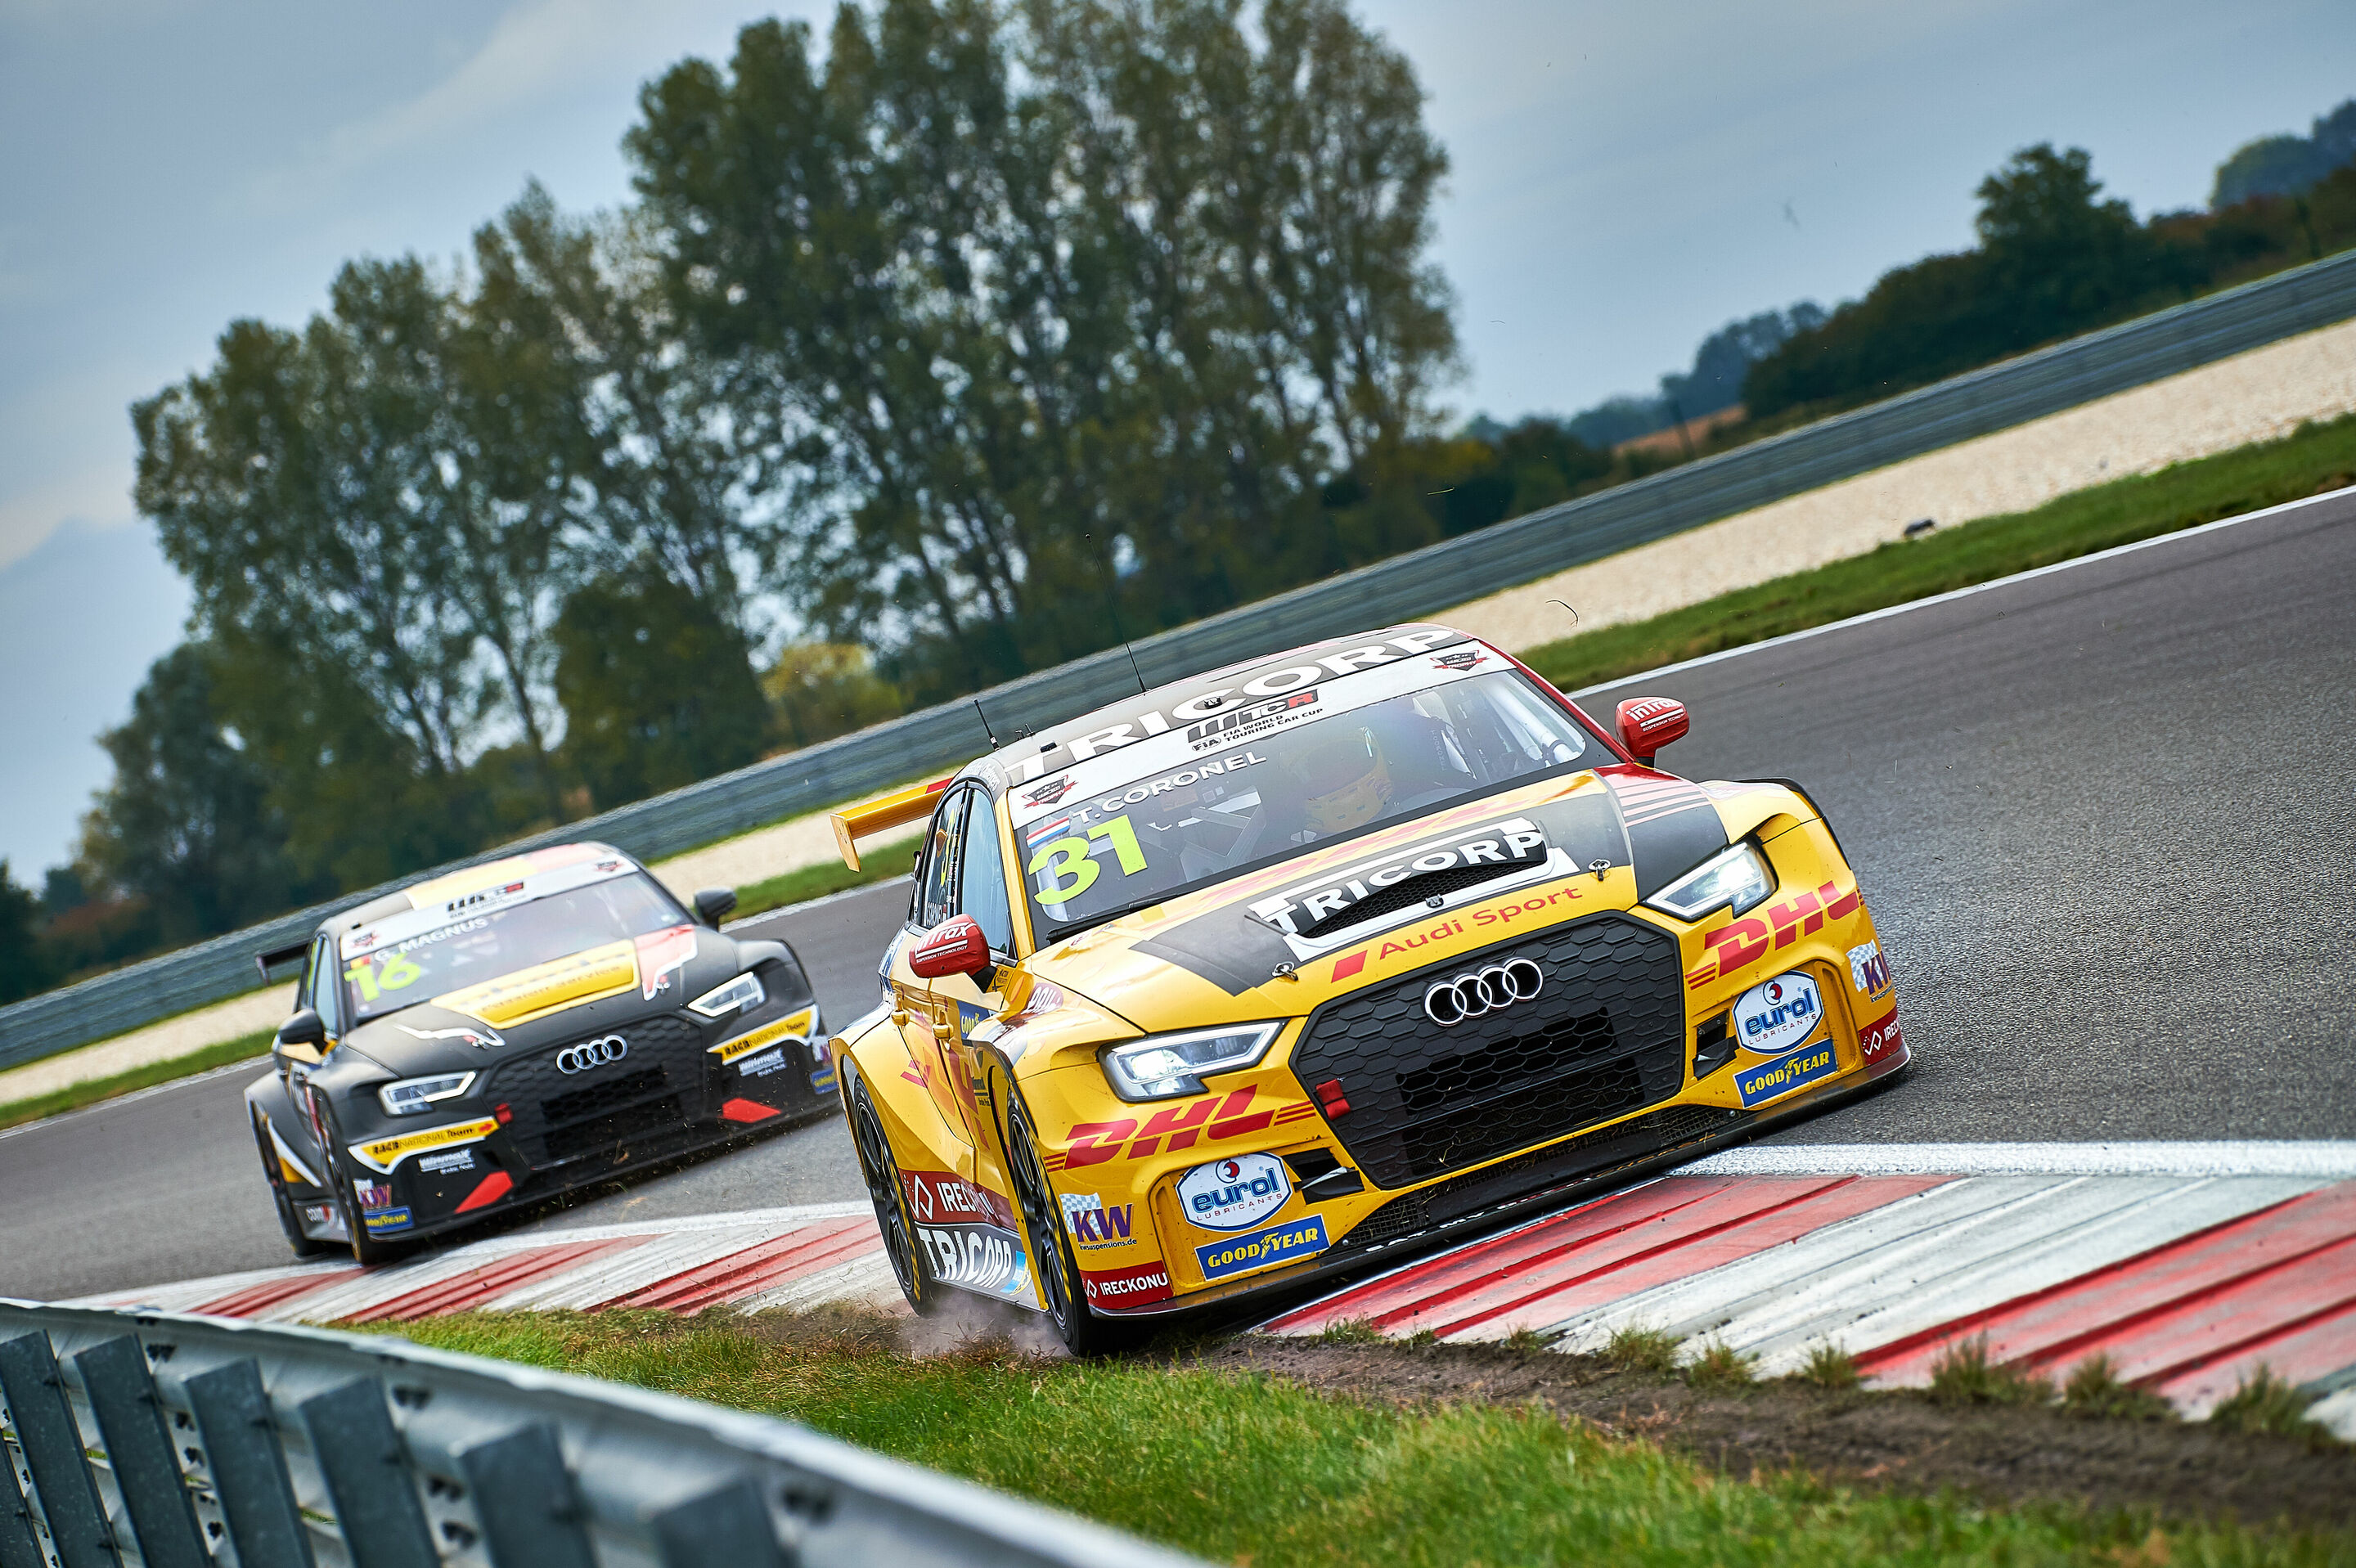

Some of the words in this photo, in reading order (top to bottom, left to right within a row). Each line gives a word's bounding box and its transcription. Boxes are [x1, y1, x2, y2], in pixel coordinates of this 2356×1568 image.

[1005, 629, 1455, 780] TRICORP
[1223, 729, 1241, 738] FIA
[1243, 715, 1284, 730] WORLD
[1225, 724, 1275, 742] TOURING
[1277, 716, 1299, 725] CAR
[1302, 708, 1324, 718] CUP
[1194, 739, 1219, 752] FIA
[1027, 814, 1148, 905] 31
[1264, 830, 1543, 933] TRICORP
[398, 918, 488, 955] MAGNUS
[1379, 918, 1462, 960] Audi
[1472, 884, 1582, 927] Sport
[1704, 880, 1860, 978] DHL
[344, 952, 421, 1003] 16
[1744, 988, 1816, 1037] eurol
[1747, 1013, 1818, 1045] LUBRICANTS
[1064, 1084, 1276, 1170] DHL
[1191, 1168, 1280, 1214] eurol
[1197, 1193, 1283, 1221] LUBRICANTS
[1072, 1203, 1134, 1242] KW
[1080, 1238, 1137, 1251] kwsuspensions.de
[916, 1228, 1012, 1289] TRICORP
[1099, 1272, 1169, 1296] IRECKONU
